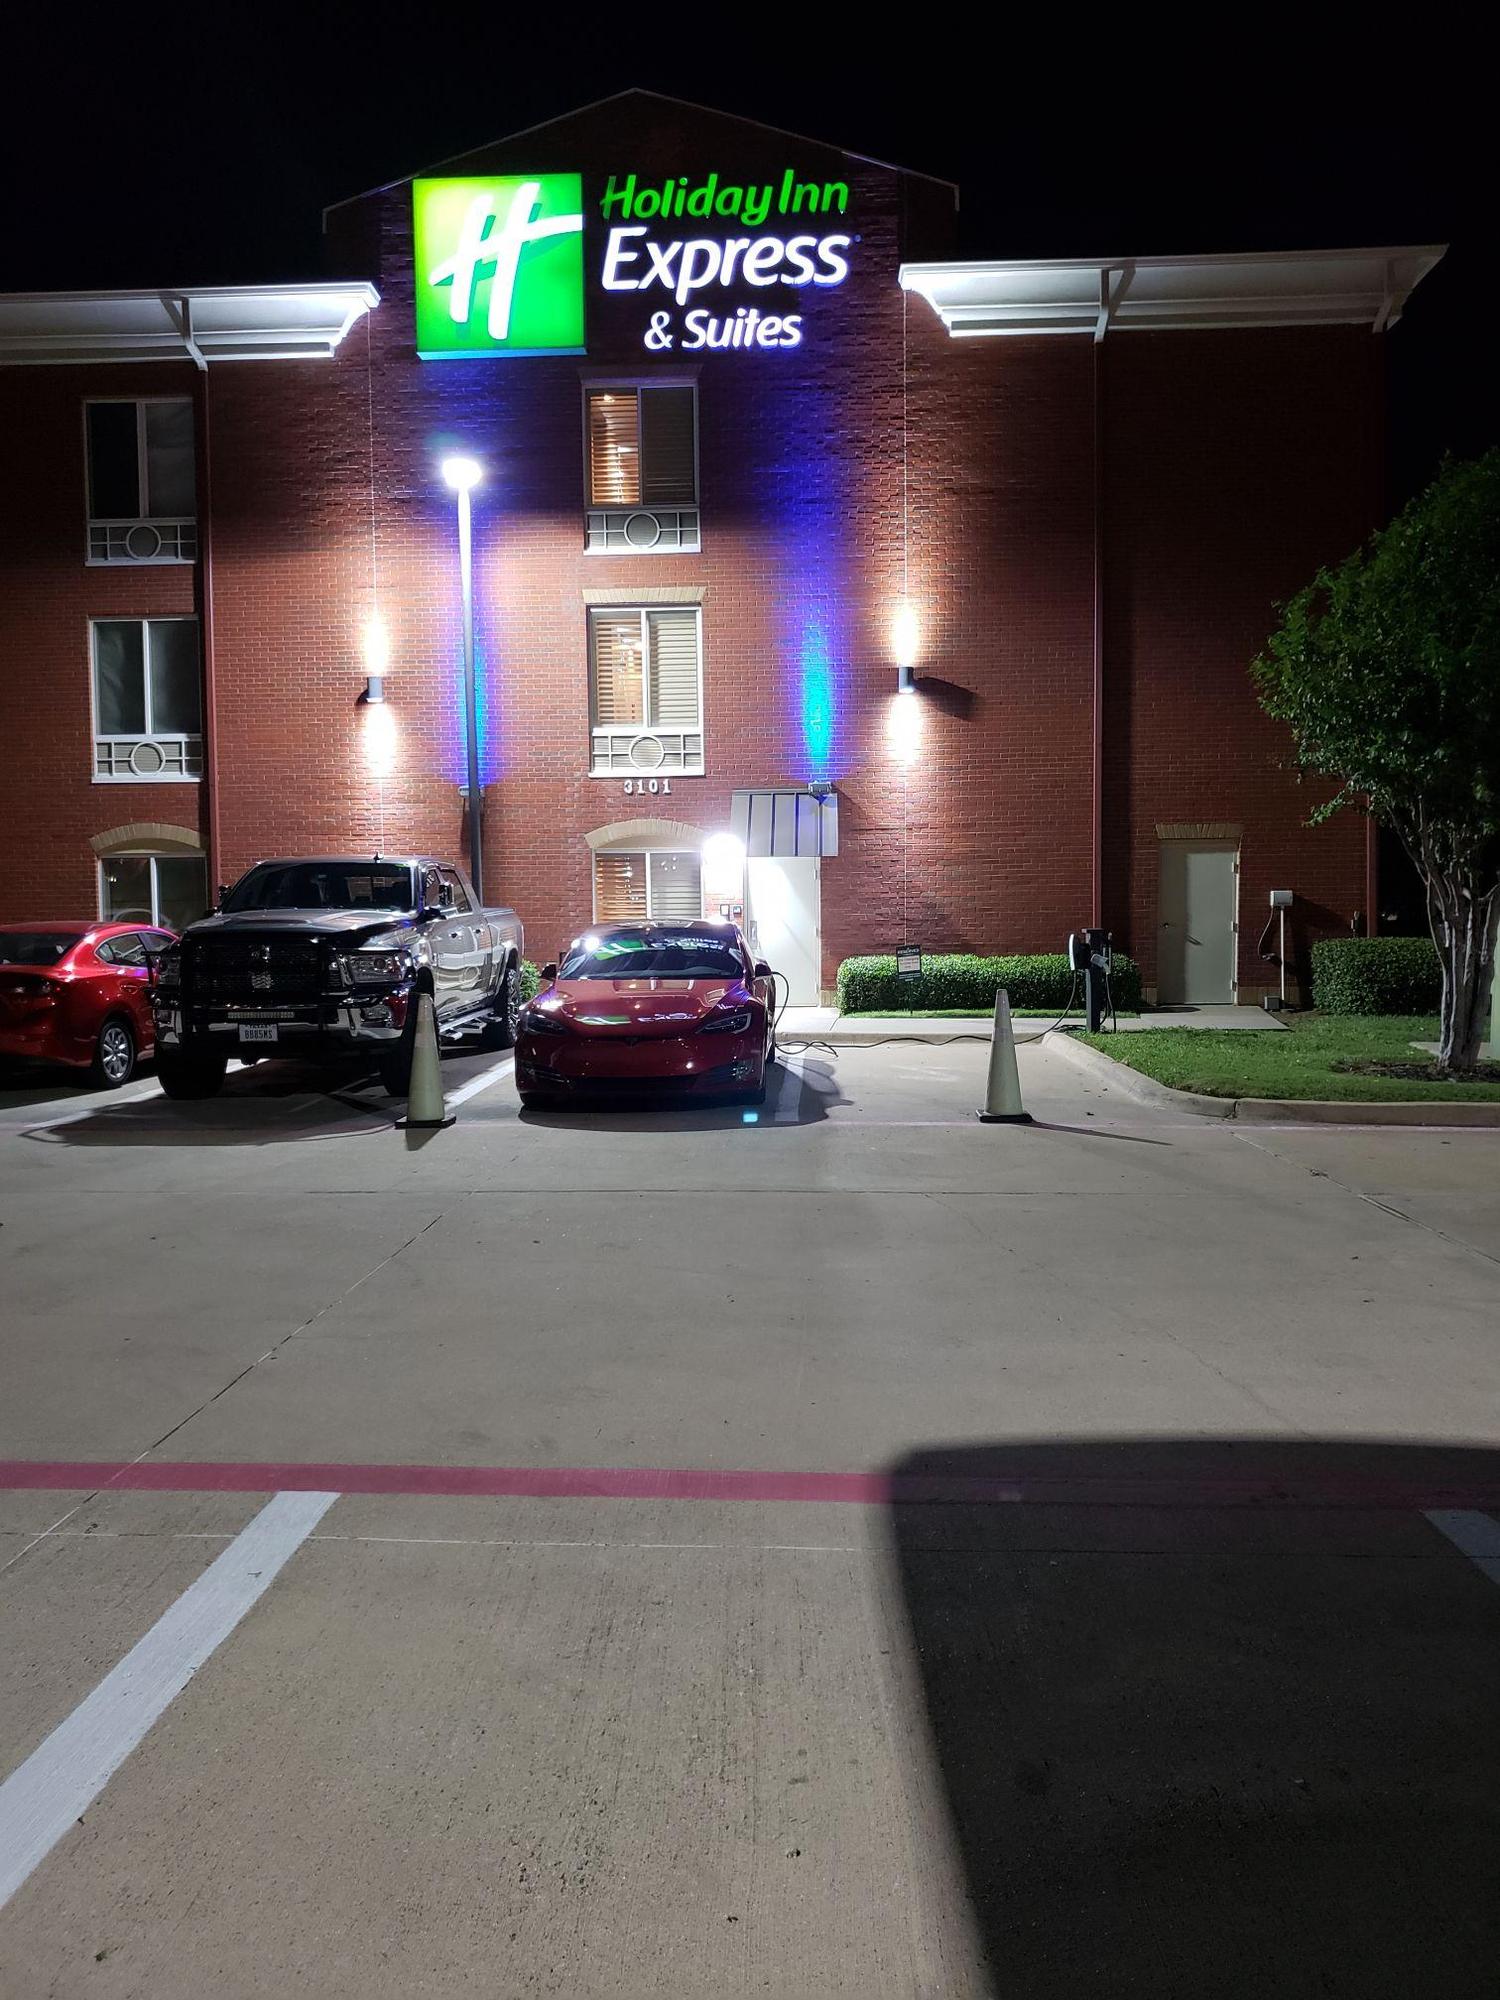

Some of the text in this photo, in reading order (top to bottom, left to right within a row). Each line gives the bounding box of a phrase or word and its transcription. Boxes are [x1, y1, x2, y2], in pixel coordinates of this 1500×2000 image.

[600, 169, 849, 226] Holiday Inn
[602, 226, 851, 306] Express
[643, 307, 803, 350] & Suites
[623, 778, 672, 795] 3101
